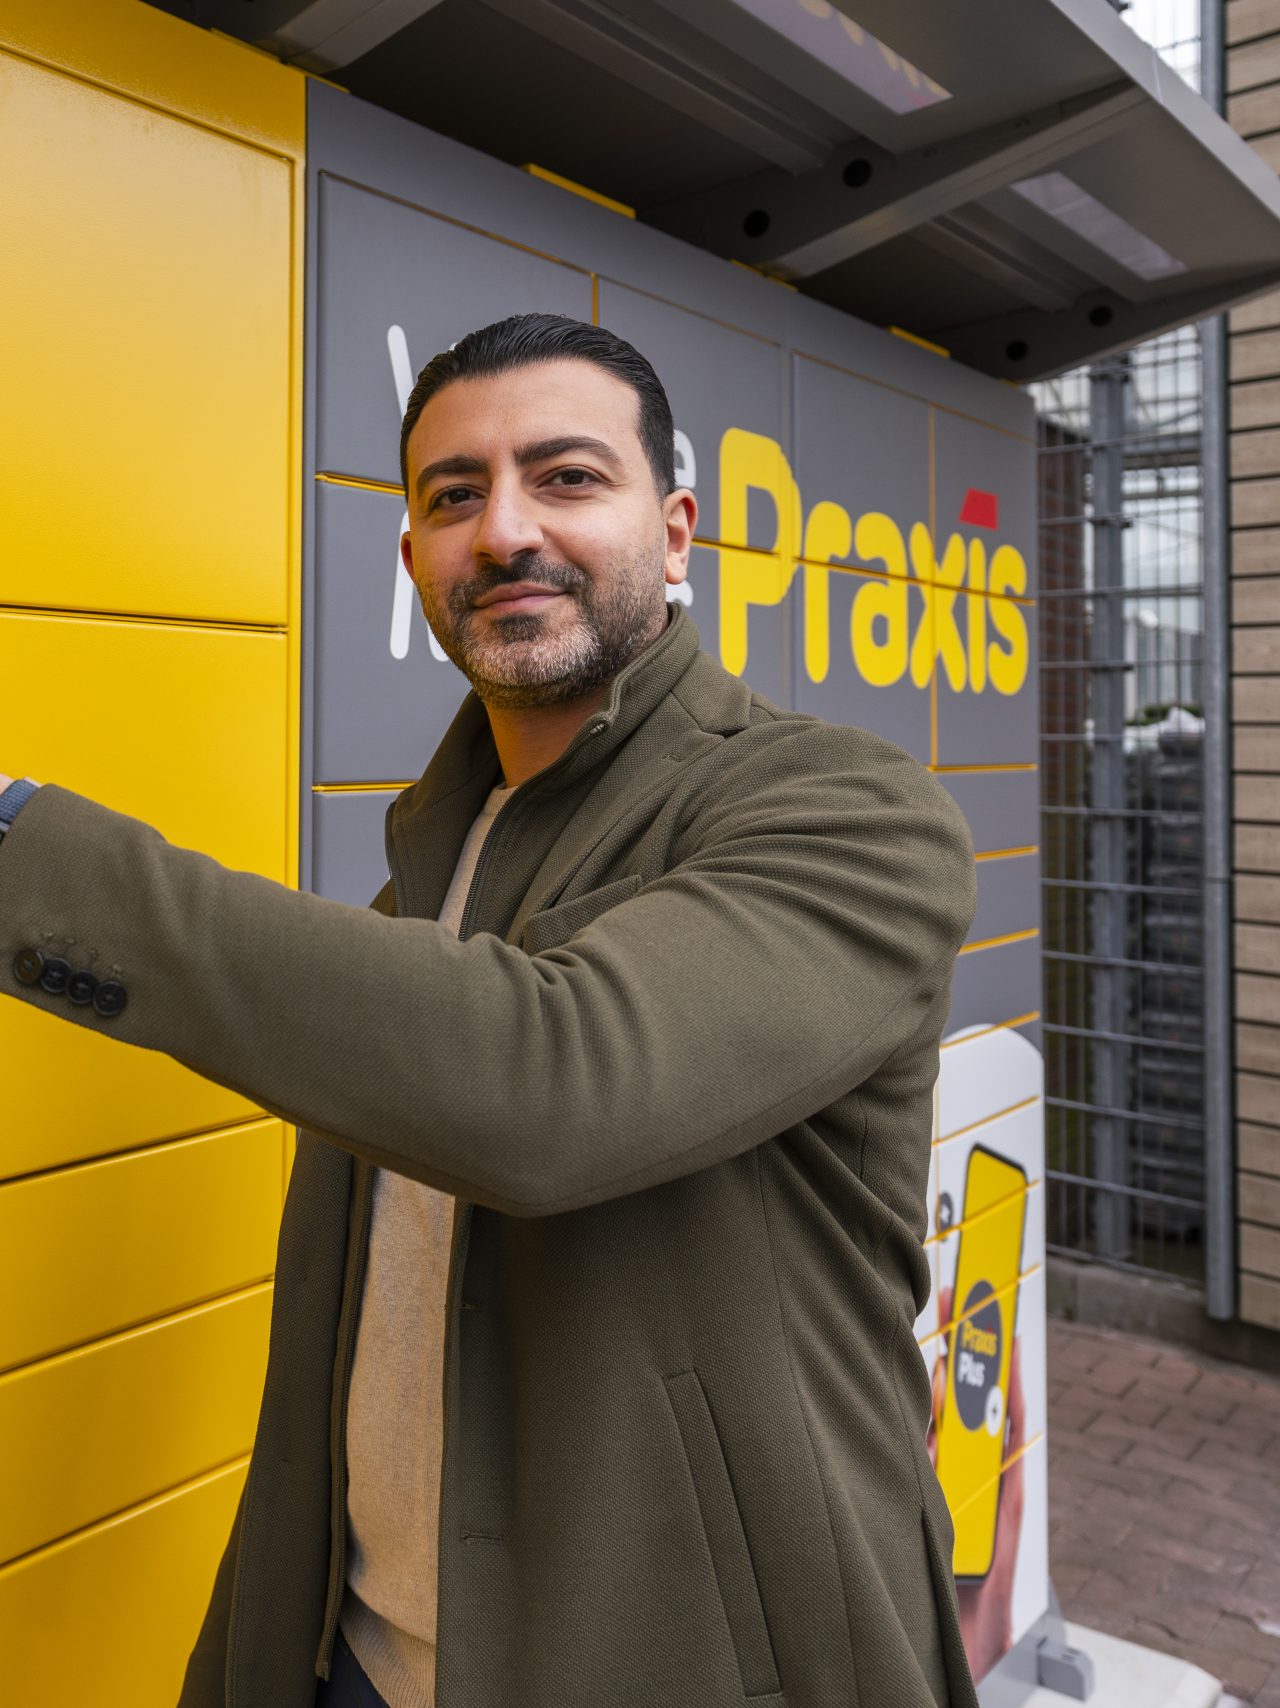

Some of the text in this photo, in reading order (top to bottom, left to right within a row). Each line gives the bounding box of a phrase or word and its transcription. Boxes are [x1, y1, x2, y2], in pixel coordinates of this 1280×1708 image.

[719, 427, 1028, 695] Praxis
[961, 1320, 997, 1357] Praxis
[957, 1352, 985, 1388] Plus
